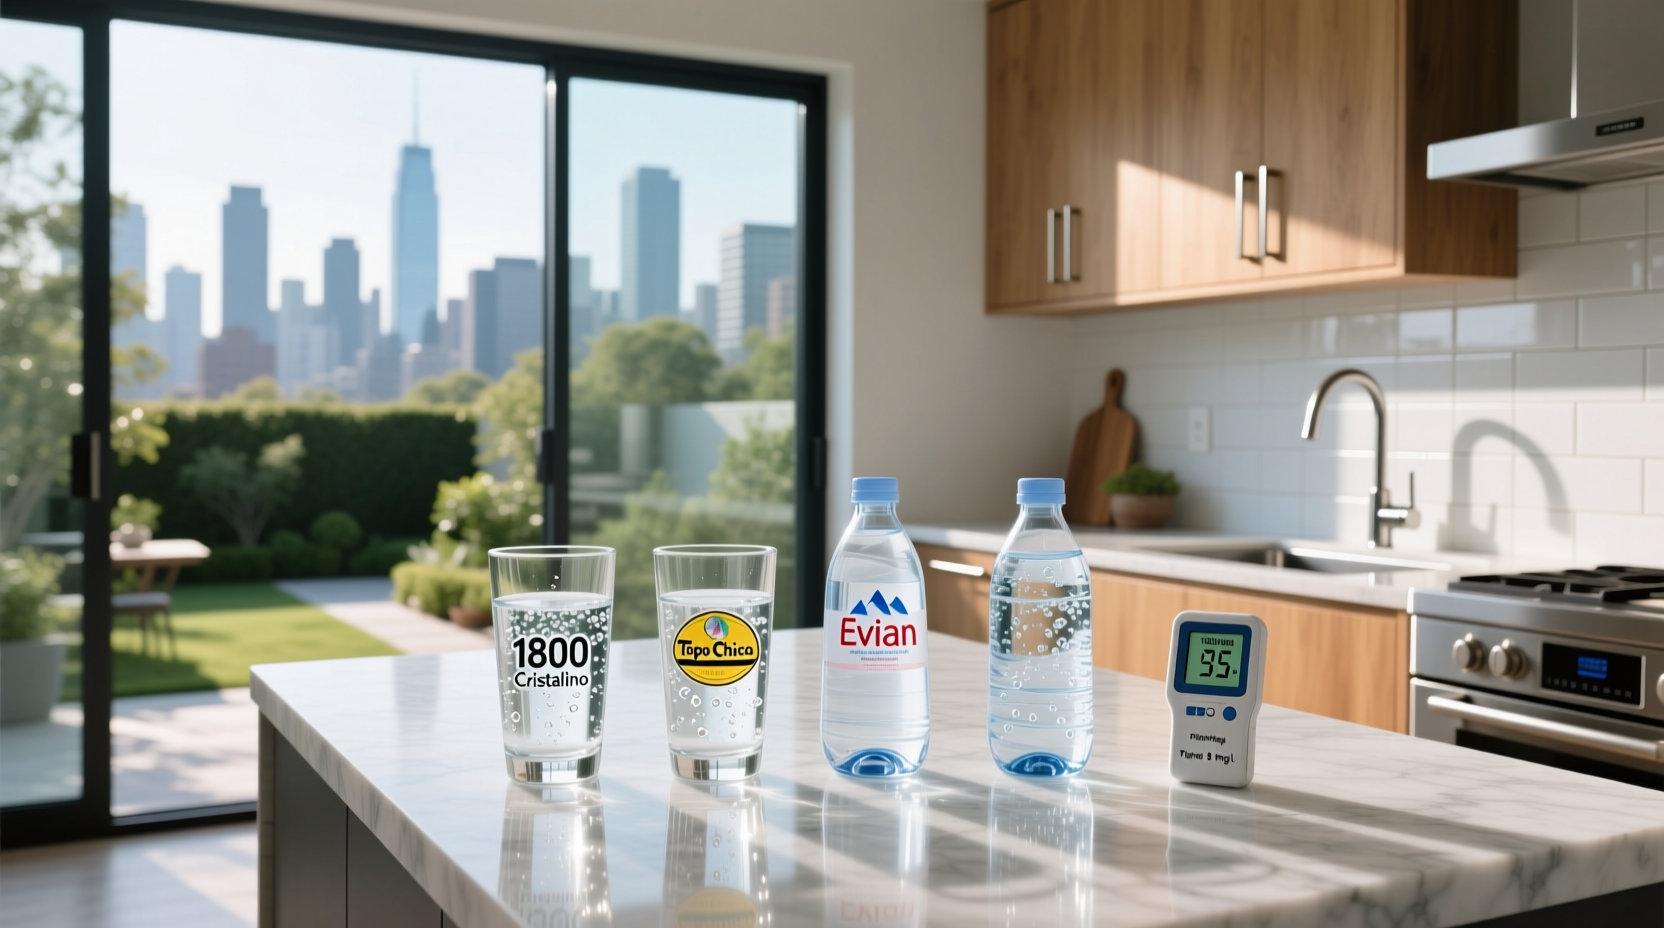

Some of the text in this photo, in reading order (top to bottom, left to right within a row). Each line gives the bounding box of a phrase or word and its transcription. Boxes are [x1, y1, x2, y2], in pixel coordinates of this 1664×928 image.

[840, 617, 917, 647] Evian
[512, 637, 589, 668] 1800
[712, 641, 754, 658] Chica
[1199, 649, 1231, 679] 95
[514, 672, 589, 687] Cristalino
